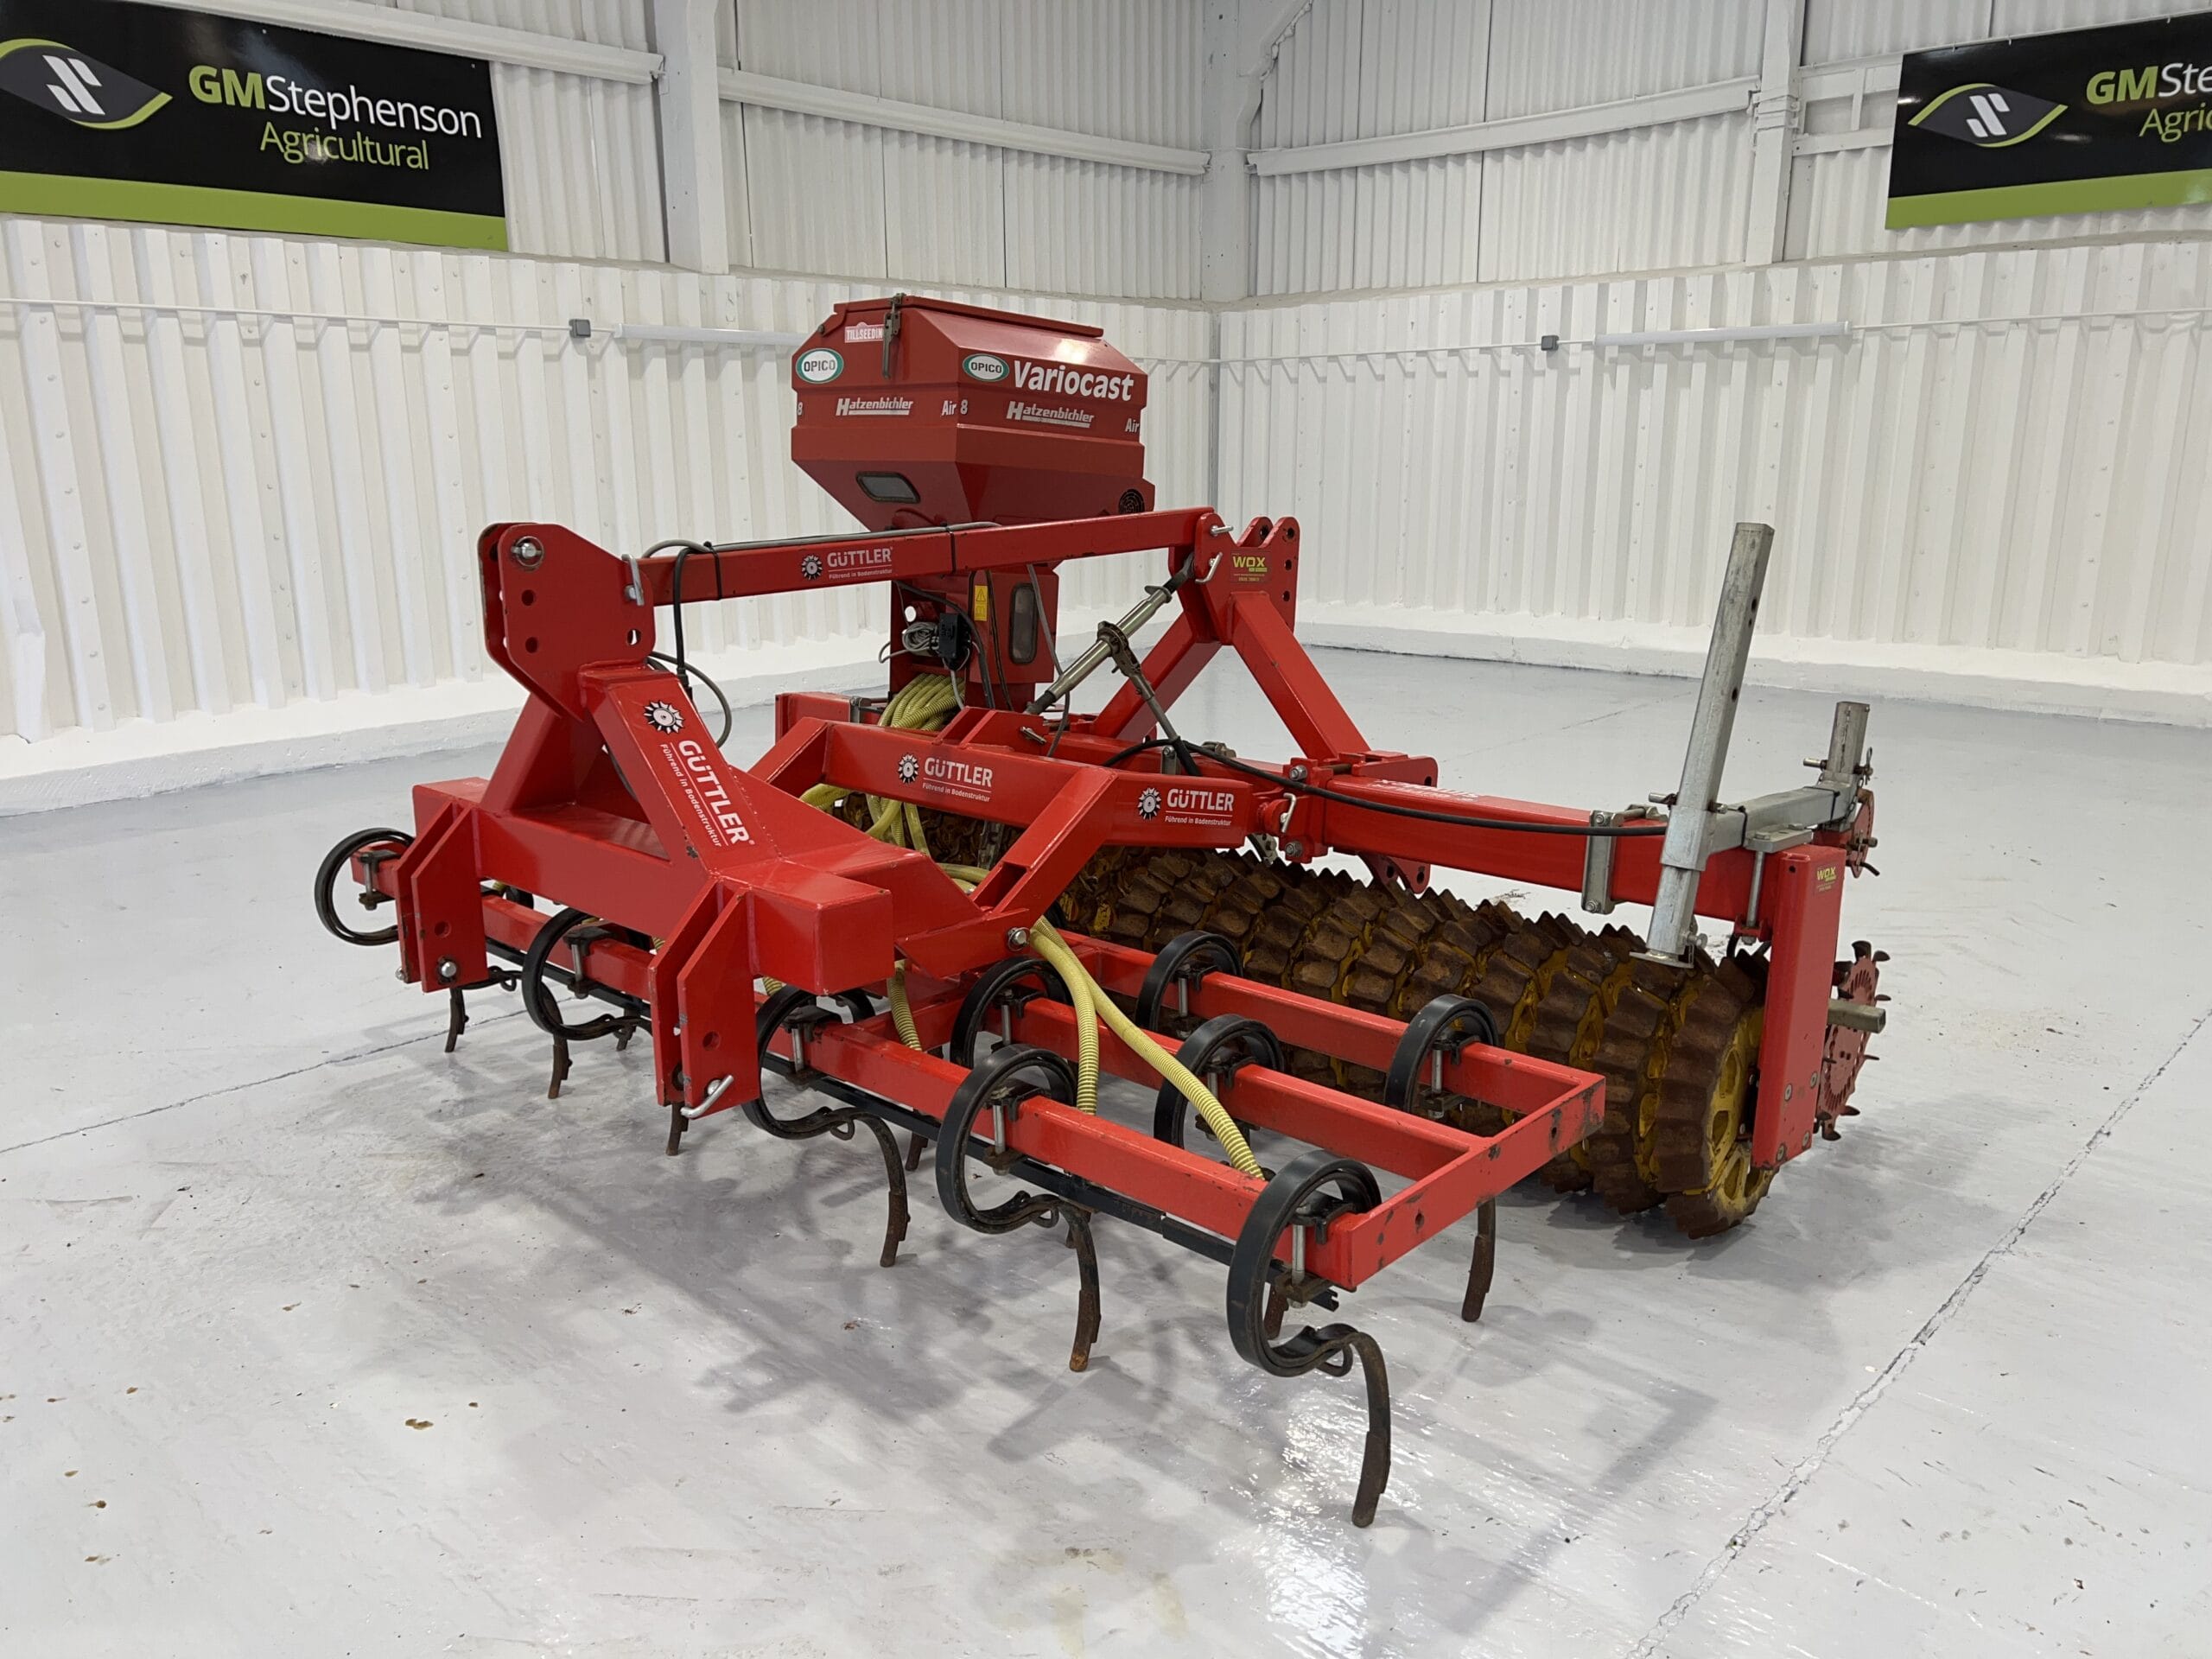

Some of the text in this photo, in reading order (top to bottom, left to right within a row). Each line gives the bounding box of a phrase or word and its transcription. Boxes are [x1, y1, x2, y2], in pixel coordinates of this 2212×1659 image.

[188, 65, 481, 138] GMStephenson
[260, 122, 429, 169] Agricultural
[847, 327, 884, 340] TILLSEEDIN
[804, 359, 837, 372] OPICO
[970, 361, 1002, 374] OPICO
[1014, 359, 1135, 402] Variocast
[836, 397, 913, 416] Hatzenbichler
[941, 399, 968, 416] Air 8
[1006, 400, 1095, 424] Hatzenbichler
[1125, 417, 1140, 433] Air
[827, 548, 892, 568] GÜTTLER
[1233, 556, 1266, 568] WOX
[925, 757, 993, 788] GÜTTLER
[659, 743, 722, 848] Führend in Bodenstruktur
[678, 740, 750, 844] GÜTTLER
[922, 782, 944, 793] Führend
[951, 787, 991, 803] Bodenstruktur
[1166, 788, 1235, 812] GÜTTLER
[1164, 815, 1188, 824] Führend
[1194, 817, 1232, 826] Bodenstruktur
